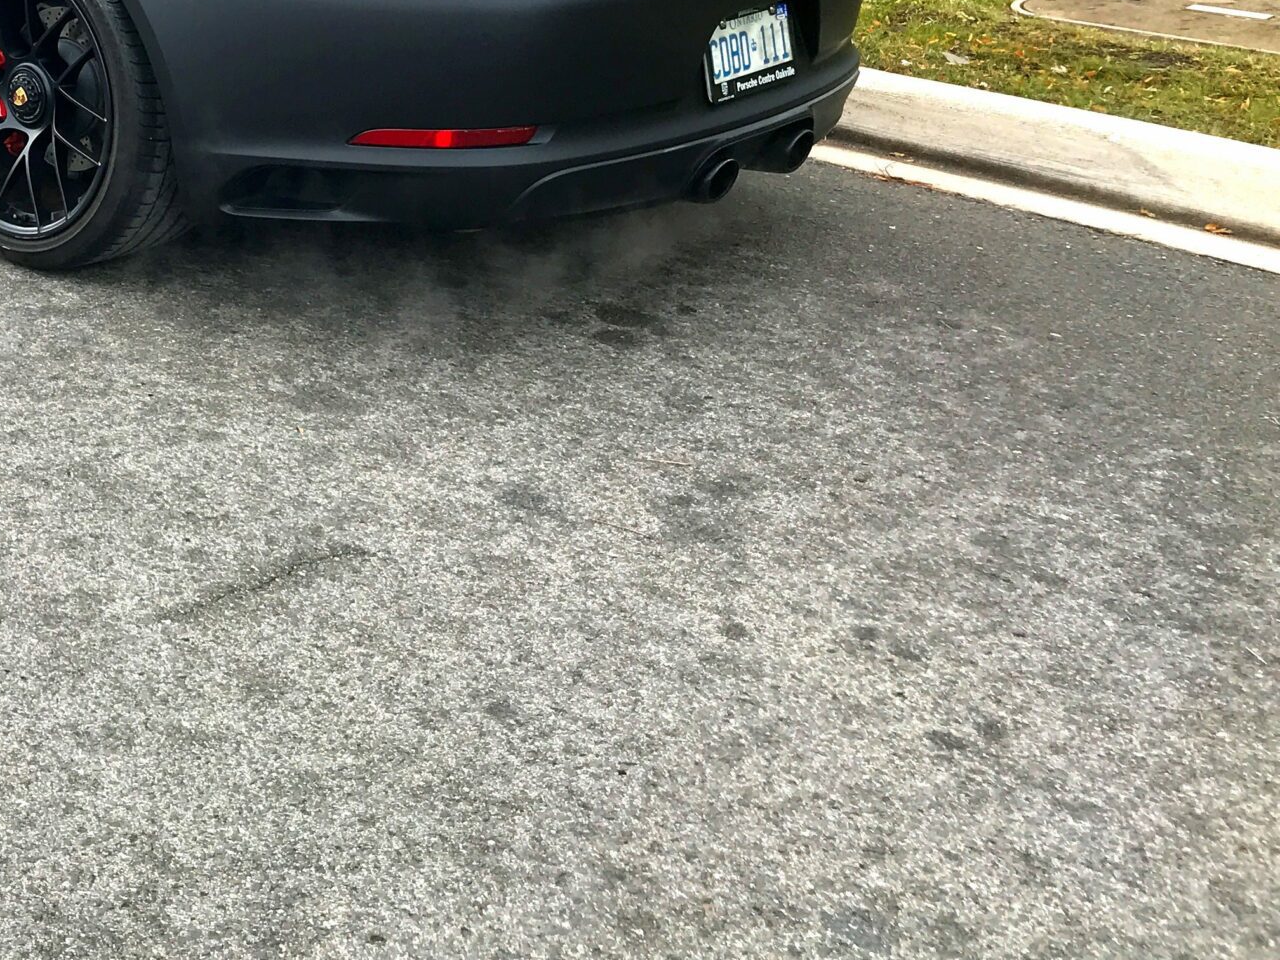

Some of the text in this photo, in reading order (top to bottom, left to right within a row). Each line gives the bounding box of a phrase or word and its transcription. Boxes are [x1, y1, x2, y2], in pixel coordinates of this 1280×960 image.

[736, 78, 758, 92] Porsche
[757, 72, 776, 86] Centre
[775, 65, 796, 80] Oakville
